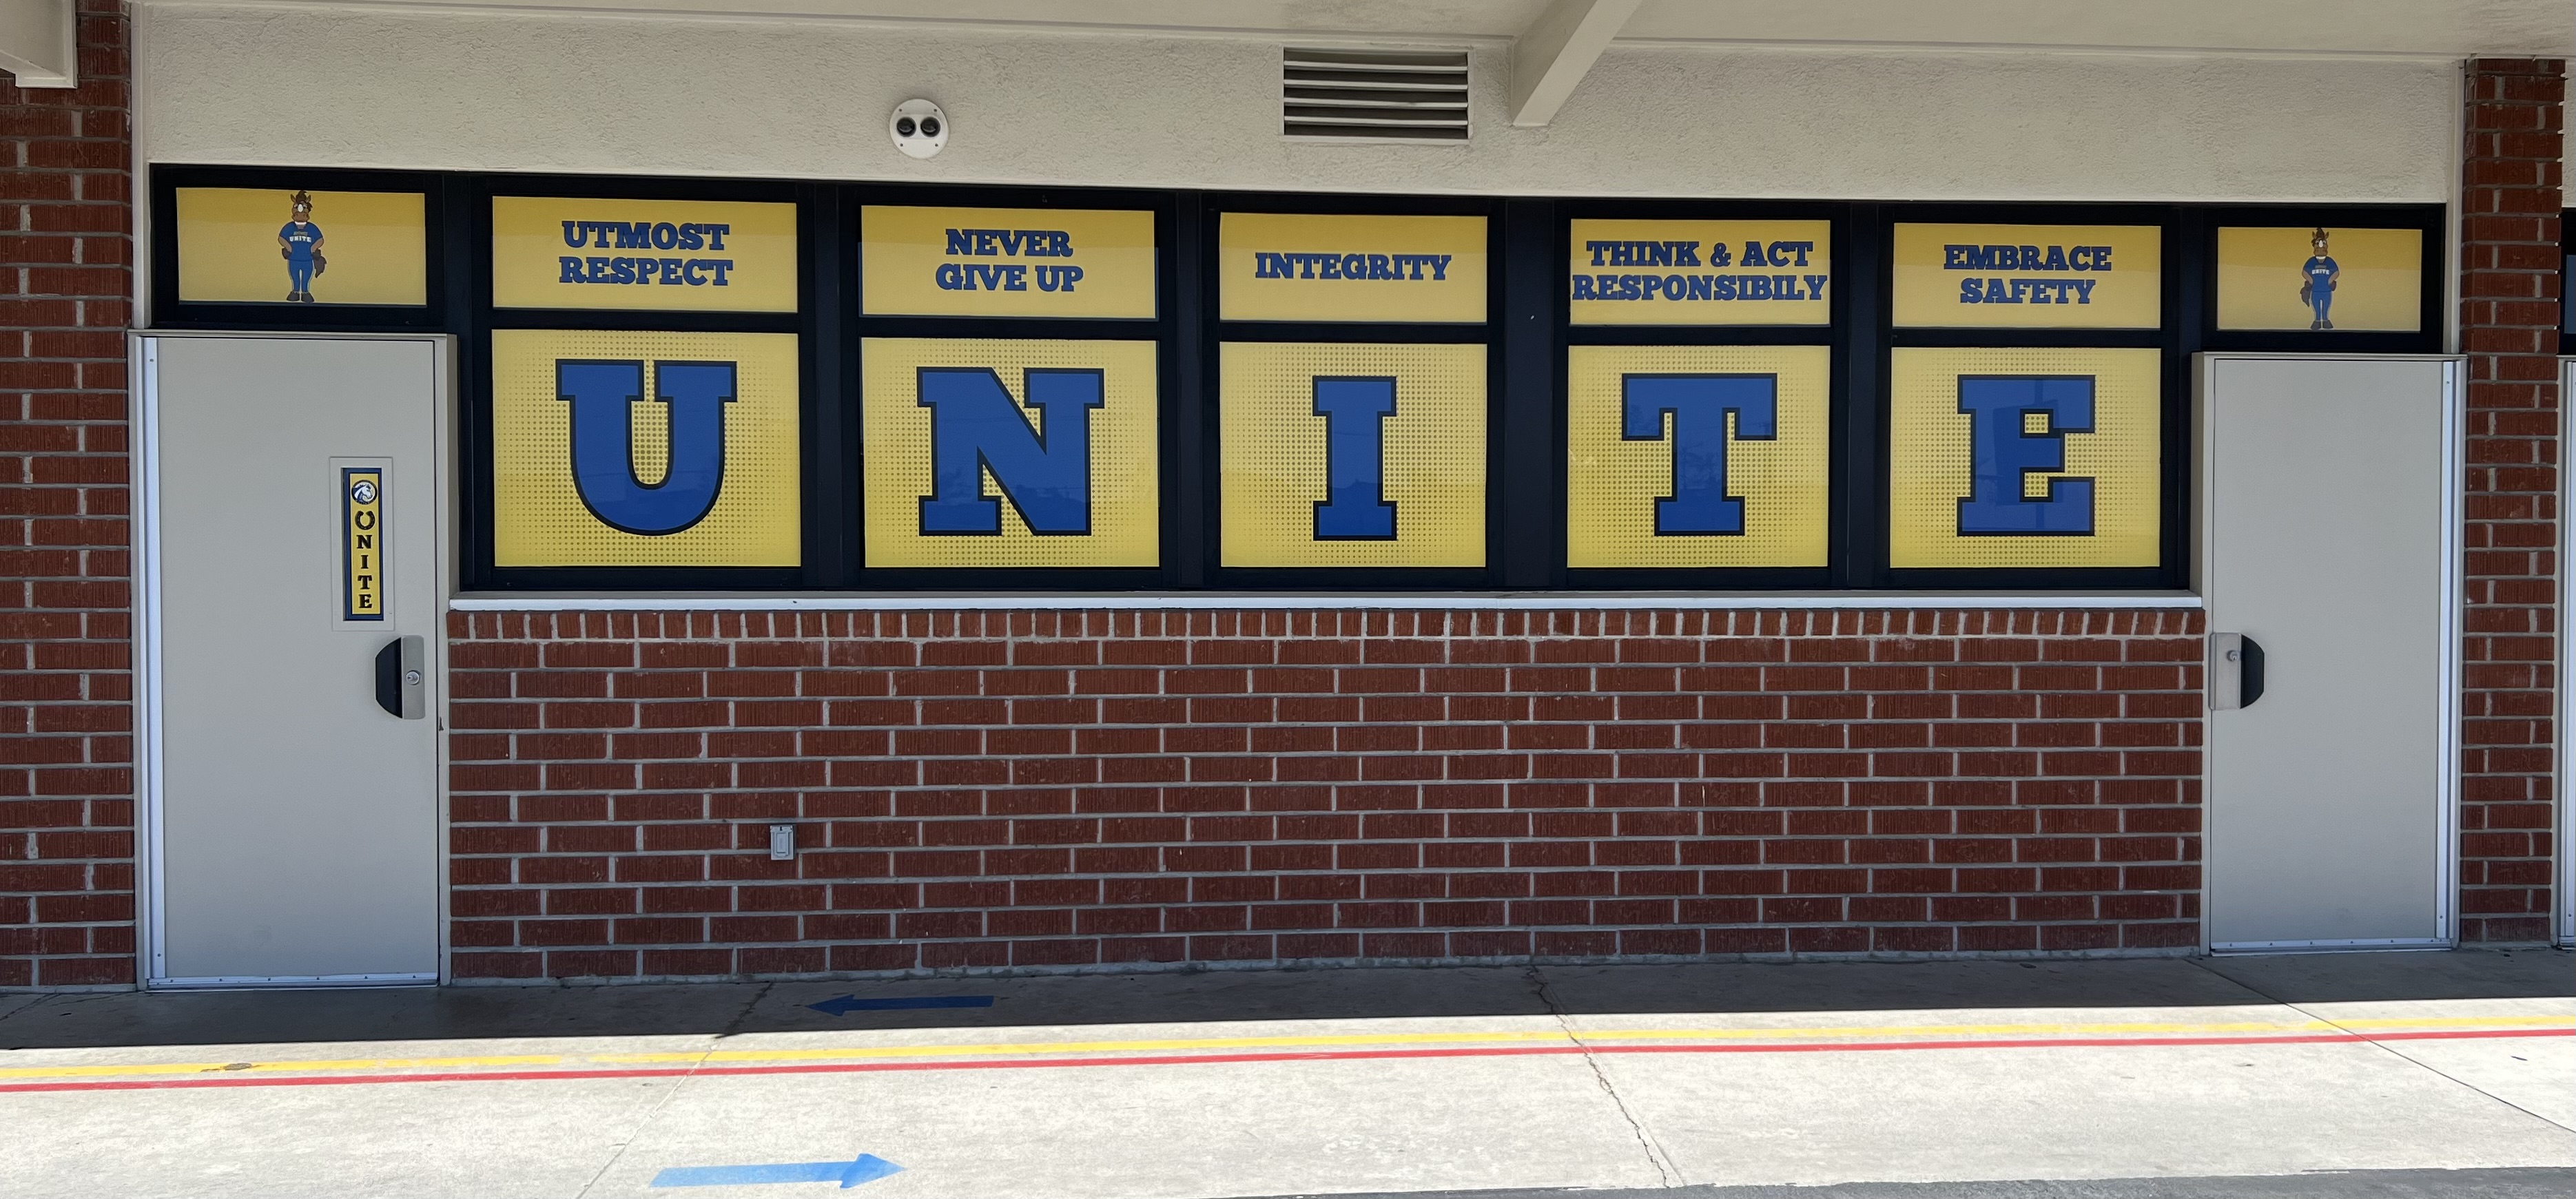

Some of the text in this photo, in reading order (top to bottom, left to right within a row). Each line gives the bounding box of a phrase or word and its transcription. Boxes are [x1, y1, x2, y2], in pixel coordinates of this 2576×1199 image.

[562, 220, 730, 251] UTMOST
[945, 229, 1073, 258] NEVER
[1255, 252, 1452, 281] INTEGRITY
[1587, 240, 1814, 268] THINK & ACT
[1944, 244, 2112, 272] EMBRACE
[559, 256, 734, 286] RESPECT
[936, 263, 1084, 293] GIVE UP
[1572, 273, 1829, 302] RESPONSIBILY
[1959, 278, 2096, 304] SAFETY
